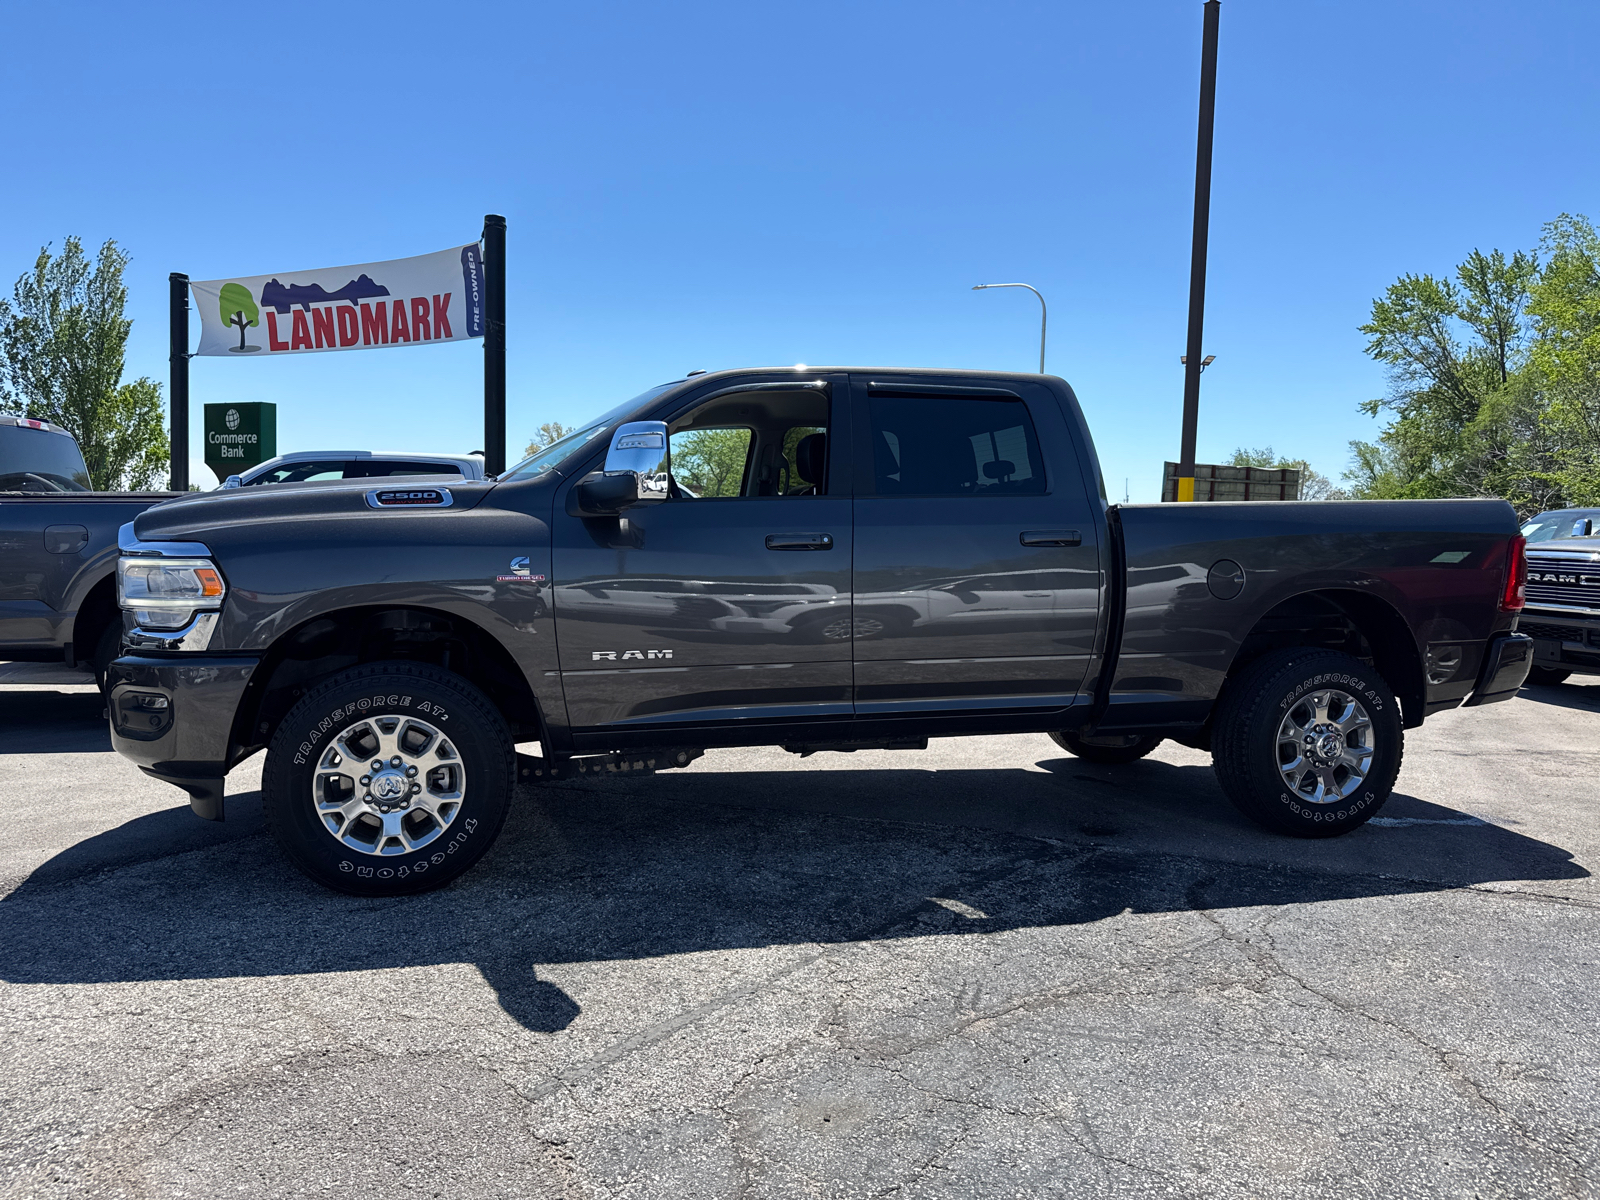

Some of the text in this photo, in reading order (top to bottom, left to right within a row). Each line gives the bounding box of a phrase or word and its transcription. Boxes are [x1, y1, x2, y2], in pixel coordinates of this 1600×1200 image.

[467, 251, 480, 331] PRE-OWNED
[266, 292, 453, 352] LANDMARK
[208, 431, 258, 444] Commerce
[221, 445, 245, 458] Bank
[1527, 573, 1576, 583] RAM
[592, 649, 673, 661] RAM
[1280, 673, 1365, 709] TRANSFORCE
[294, 695, 412, 766] TRANSFORCE
